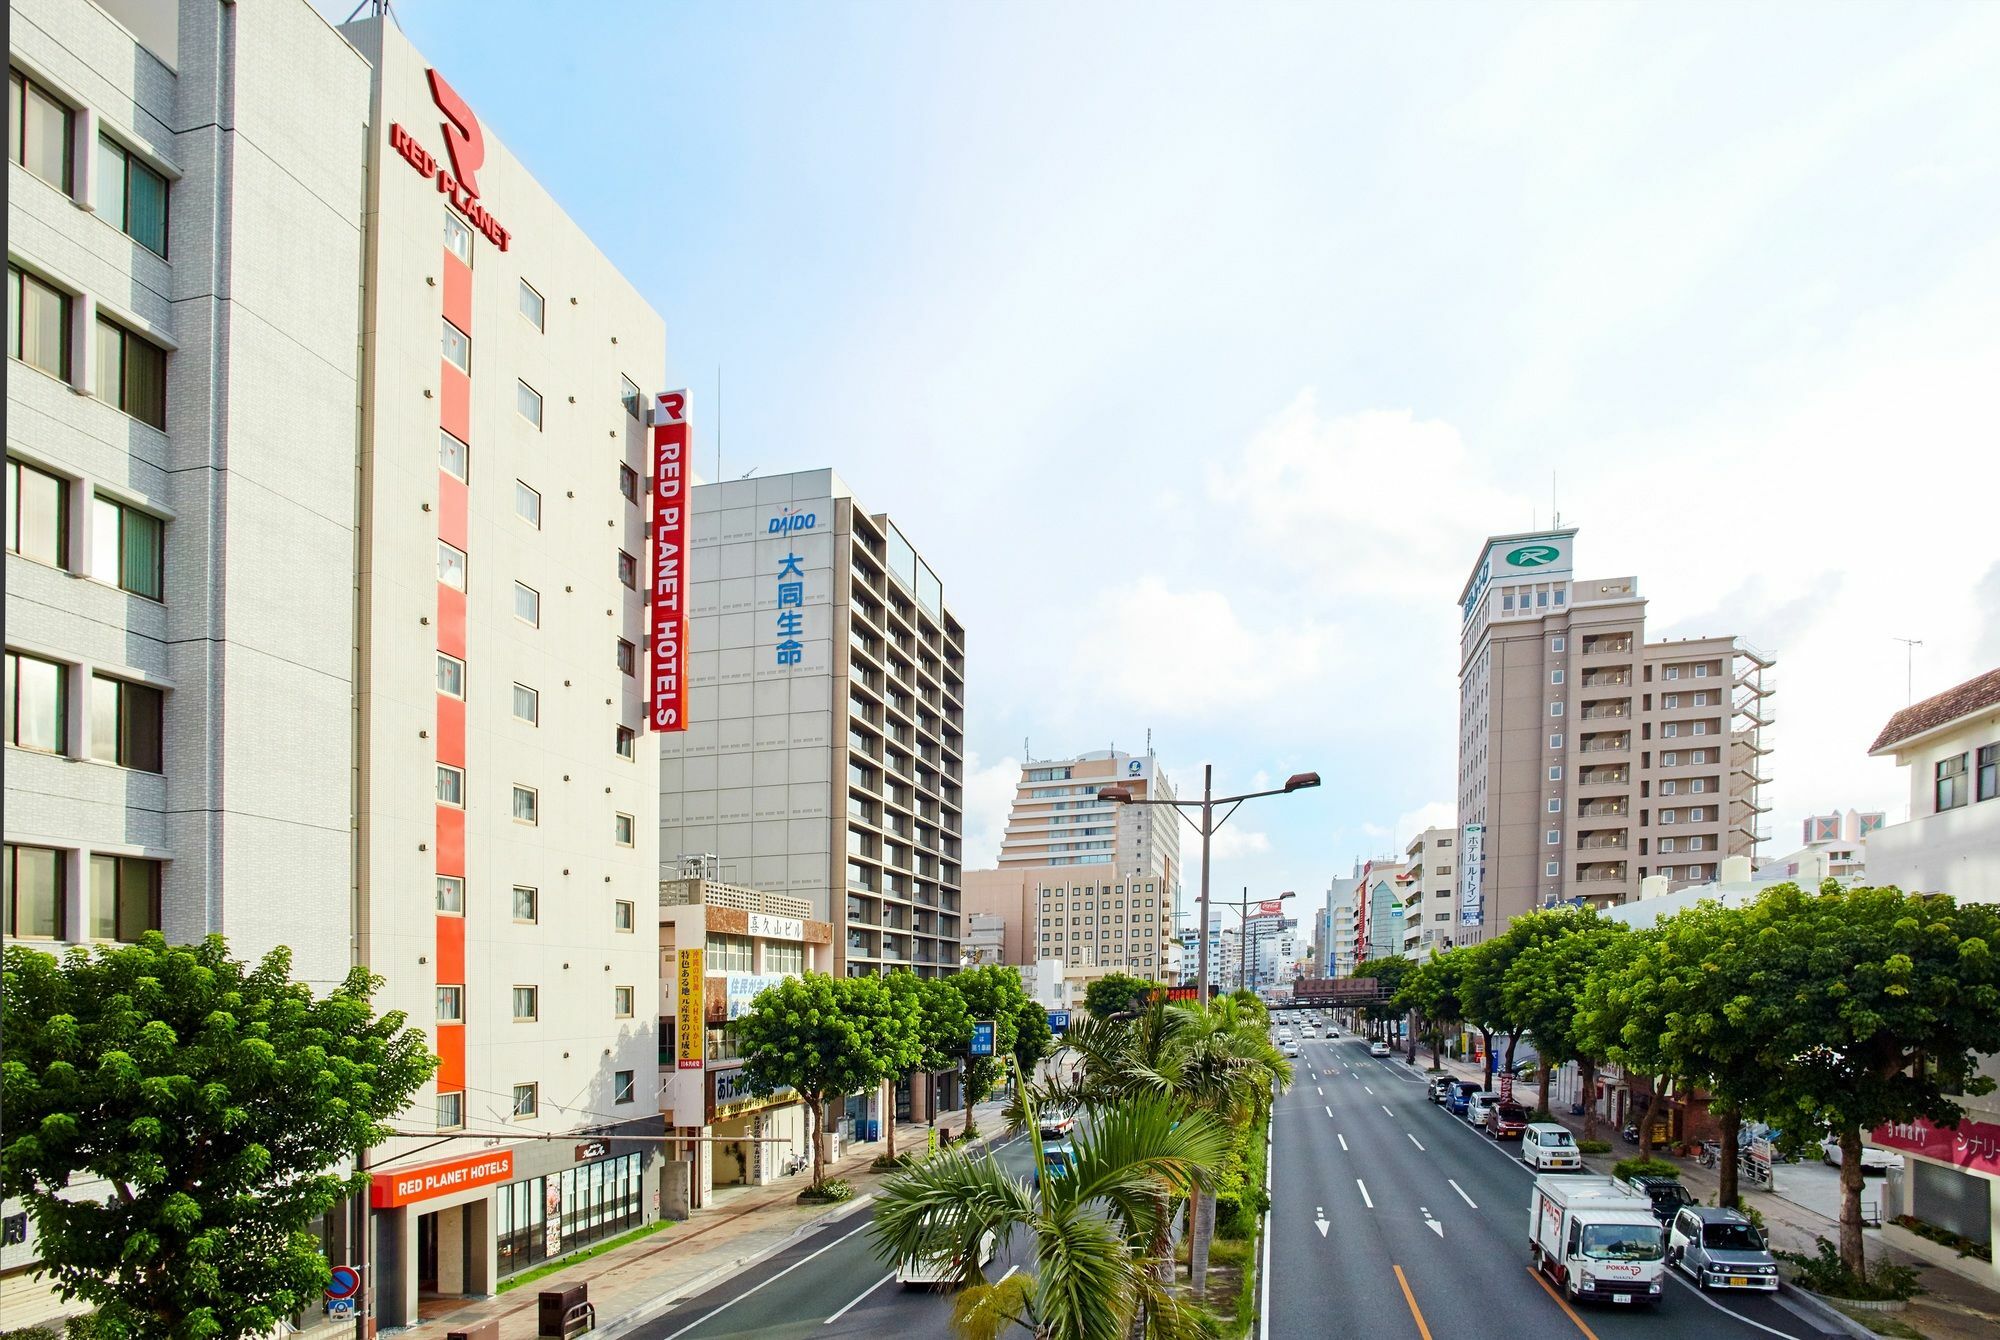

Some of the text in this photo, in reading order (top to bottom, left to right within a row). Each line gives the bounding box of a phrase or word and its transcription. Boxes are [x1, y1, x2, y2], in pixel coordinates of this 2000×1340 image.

[390, 121, 512, 253] RED PLANET
[768, 513, 816, 535] DAIDO
[657, 442, 680, 726] RED PLANET HOTELS
[776, 552, 804, 666] 大同生命
[1467, 836, 1479, 862] ホテル
[1466, 867, 1478, 903] ルートイン
[750, 915, 802, 938] 喜久山ビル
[398, 1160, 509, 1196] RED PLANET HOTELS
